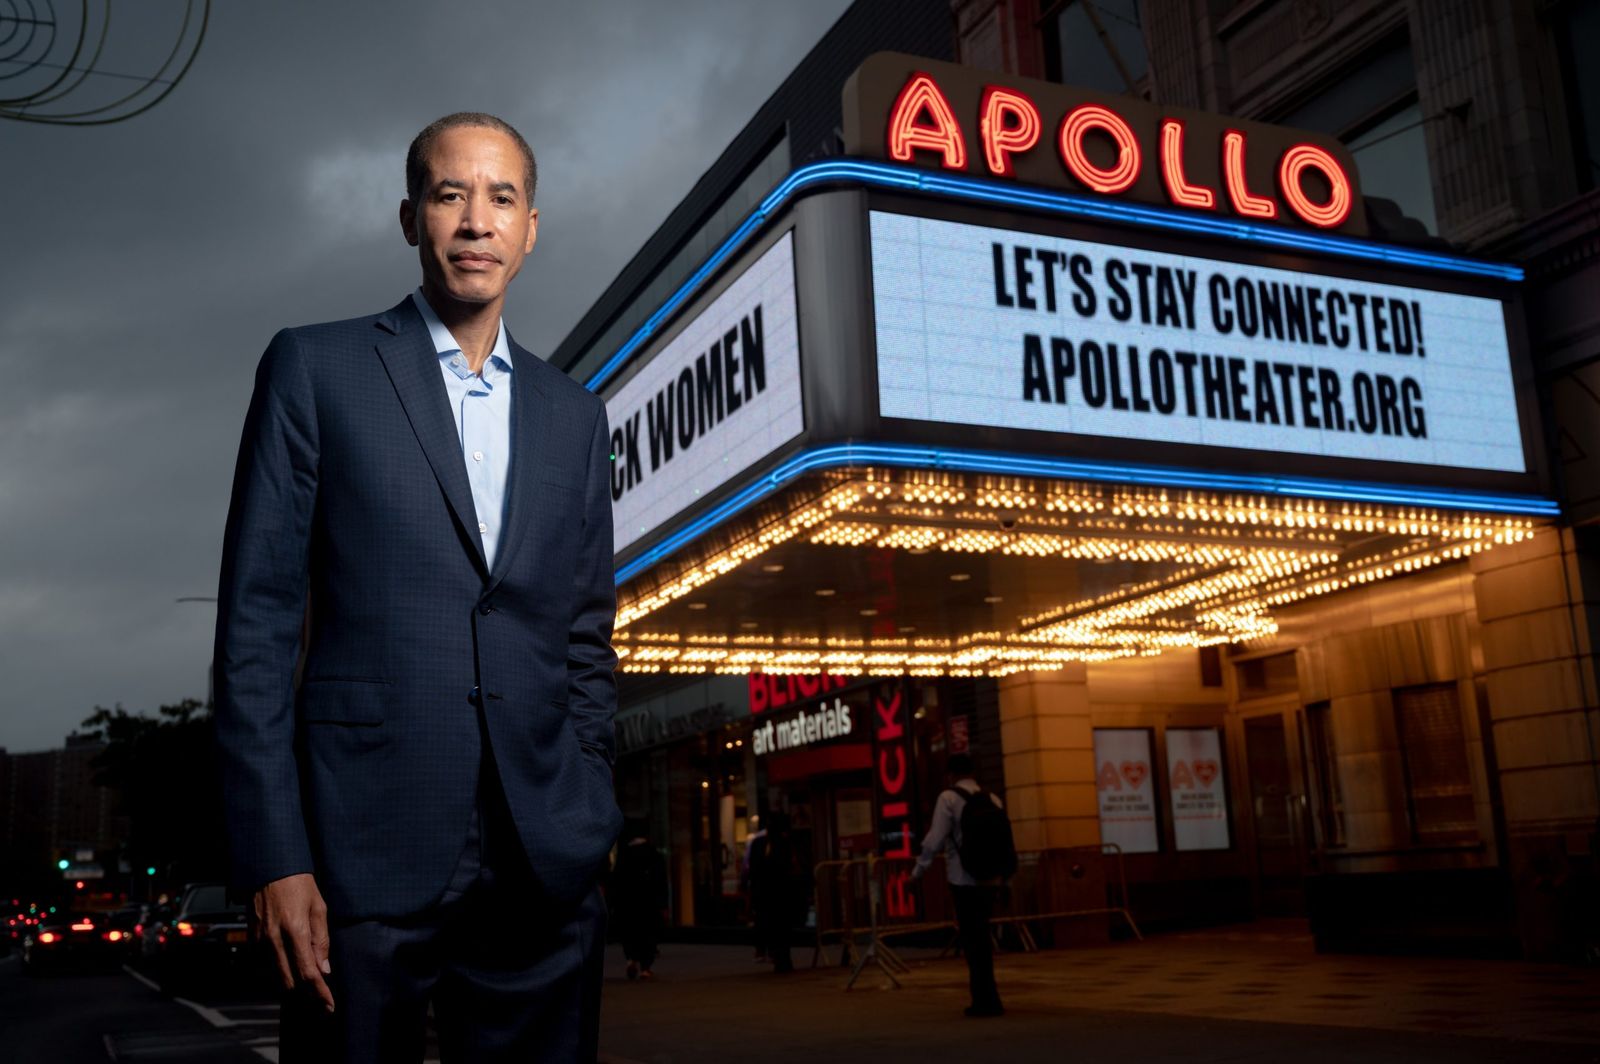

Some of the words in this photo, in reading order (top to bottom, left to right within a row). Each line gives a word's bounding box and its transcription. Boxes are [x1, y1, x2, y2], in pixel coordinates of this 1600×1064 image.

[888, 72, 1353, 228] APOLLO
[1105, 258, 1197, 330] STAY
[1208, 273, 1426, 358] CONNECTED!
[647, 304, 766, 473] WOMEN
[1022, 333, 1428, 439] APOLLOTHEATER.ORG
[752, 718, 776, 756] art
[776, 697, 853, 751] materials
[876, 690, 915, 917] BLICK
